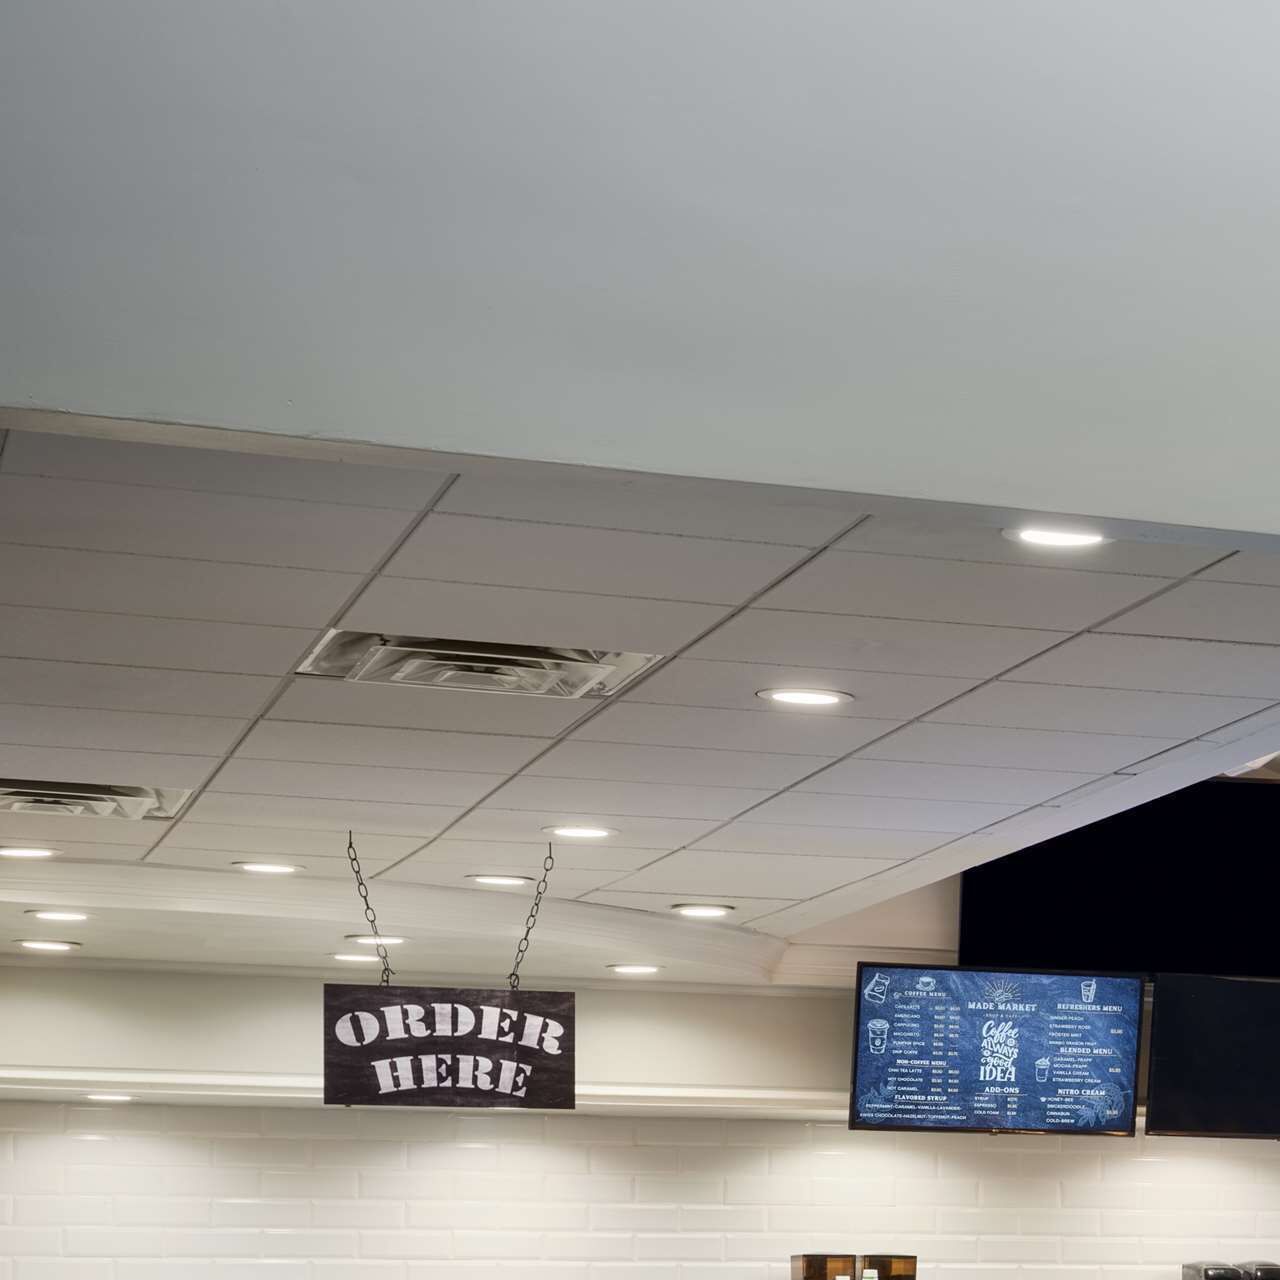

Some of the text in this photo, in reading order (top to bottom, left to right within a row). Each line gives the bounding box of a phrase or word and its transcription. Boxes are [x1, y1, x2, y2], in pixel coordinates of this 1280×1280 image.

[968, 1001, 1038, 1012] MADE MARKET
[1057, 1003, 1101, 1011] REFRESHERS
[335, 1003, 564, 1055] ORDER
[982, 1020, 1019, 1043] Coffee
[981, 1037, 1019, 1058] ALWAYS
[981, 1055, 1013, 1070] good
[371, 1054, 533, 1098] HERE
[979, 1066, 1016, 1081] IDEA
[985, 1086, 1020, 1094] ADD-ONS
